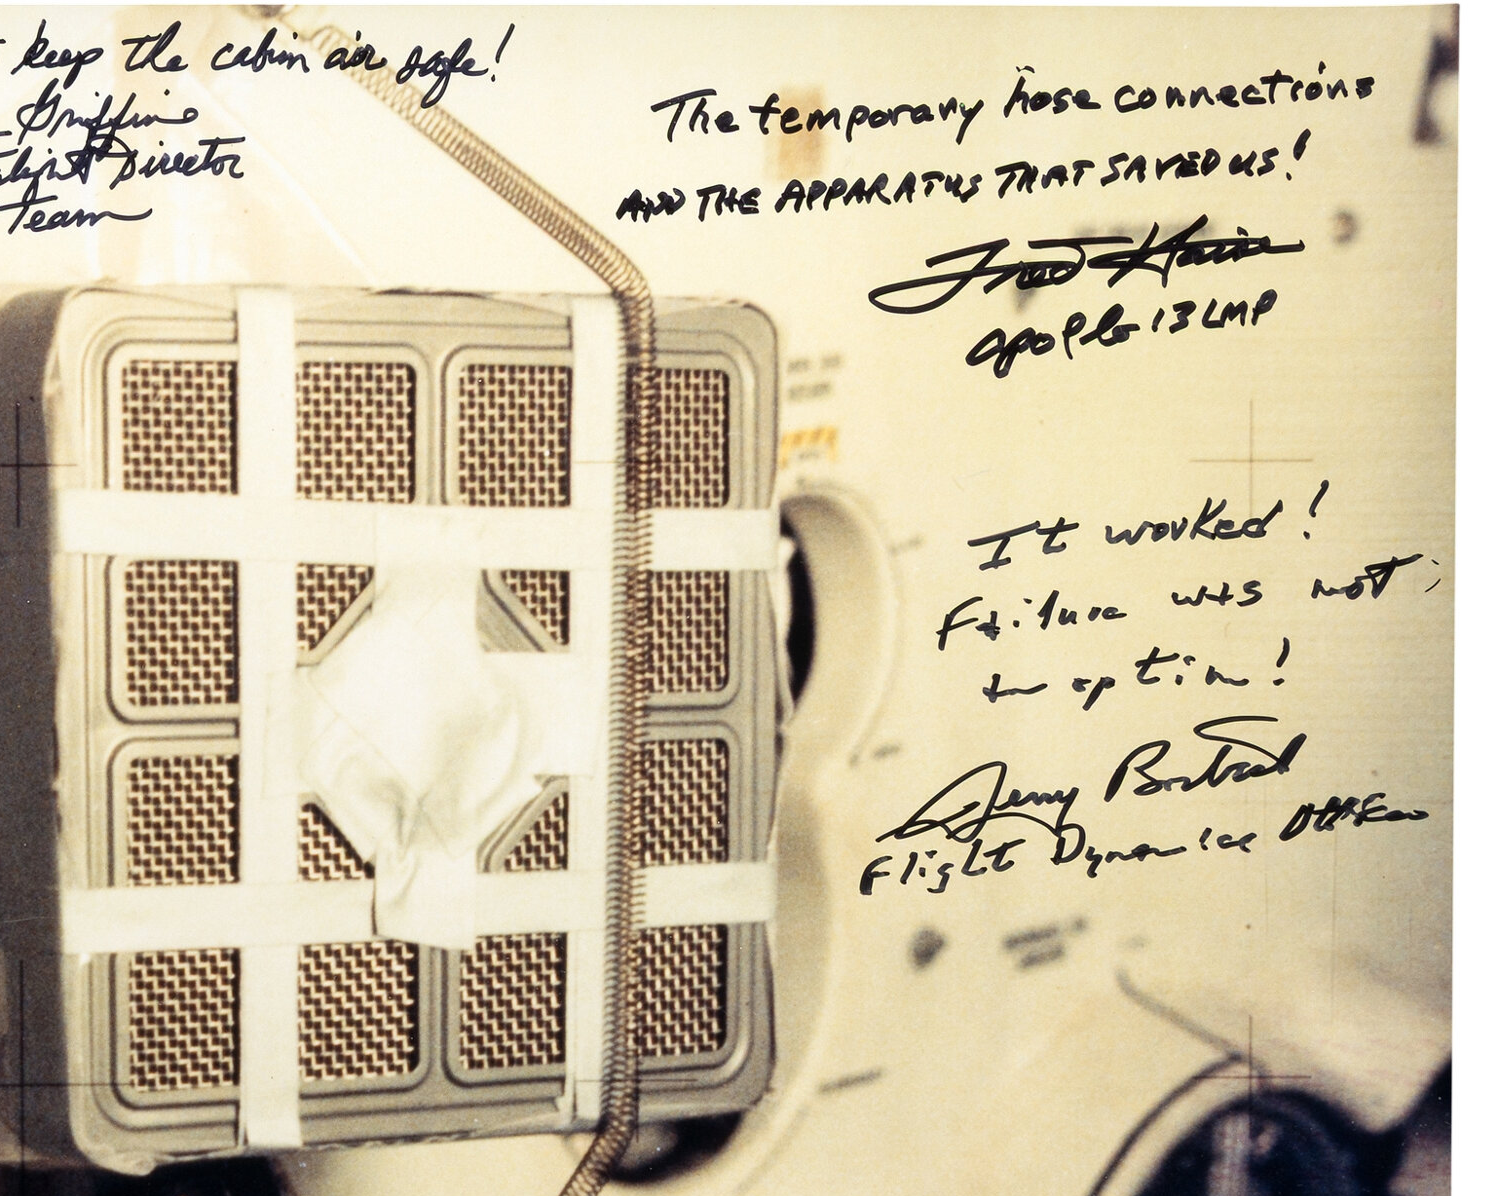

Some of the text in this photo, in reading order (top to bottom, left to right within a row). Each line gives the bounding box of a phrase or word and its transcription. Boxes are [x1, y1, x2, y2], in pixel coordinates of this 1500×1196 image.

[10, 19, 104, 90] keep
[210, 22, 310, 76] cabin
[323, 30, 388, 71] air
[395, 23, 516, 109] safe!
[650, 61, 1376, 145] The temporary hose connections
[92, 136, 246, 190] Director
[615, 187, 686, 223] AND
[696, 184, 762, 222] THE
[774, 170, 983, 214] APPARATUS
[994, 159, 1096, 199] THAT
[1100, 148, 1221, 187] SAVED
[1151, 300, 1197, 335] 13
[1201, 289, 1278, 329] LMP
[967, 516, 1080, 571] It
[859, 838, 1026, 896] Flight
